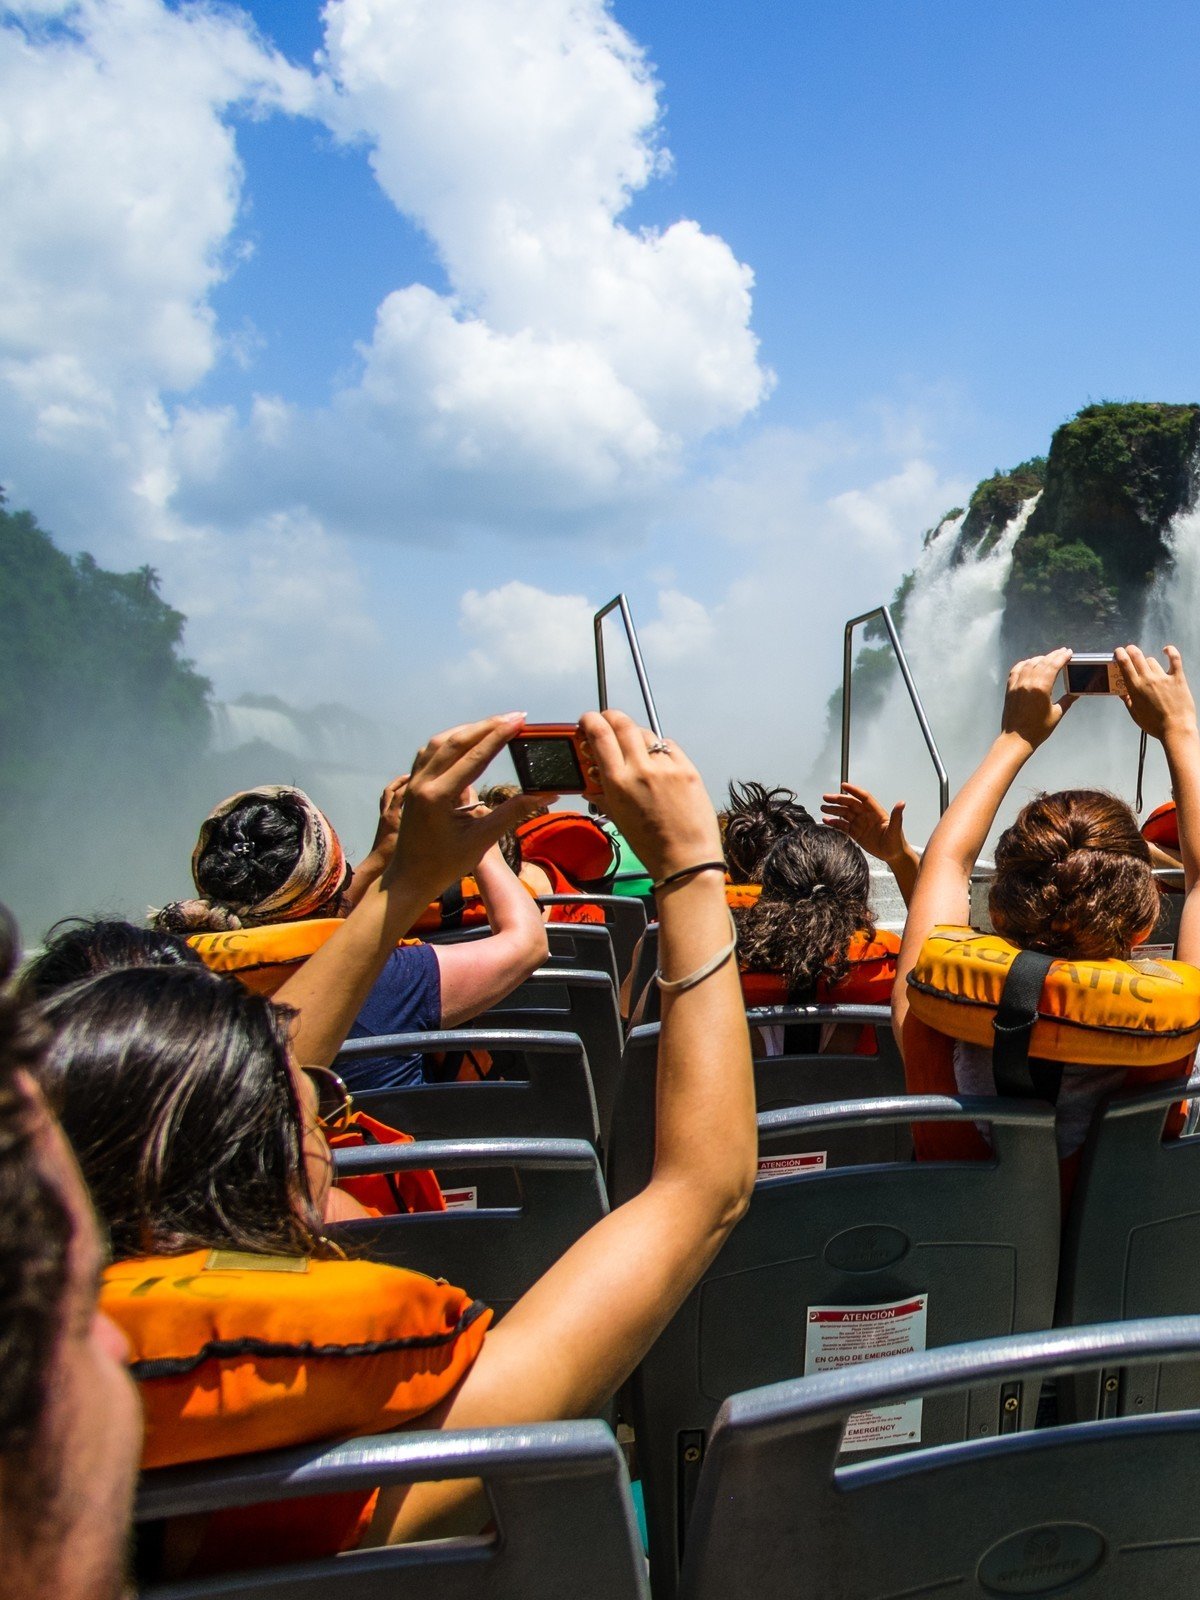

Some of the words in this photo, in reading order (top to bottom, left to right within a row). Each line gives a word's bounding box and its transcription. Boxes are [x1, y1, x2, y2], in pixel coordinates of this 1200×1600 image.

[941, 943, 1156, 1004] AQATIC
[761, 1160, 801, 1169] ATENCIÓN
[842, 1309, 895, 1321] ATENCIÓN
[815, 1356, 826, 1364] EN
[827, 1354, 851, 1363] CASO
[864, 1346, 915, 1360] EMERGENCIA
[848, 1423, 896, 1436] EMERGENCY
